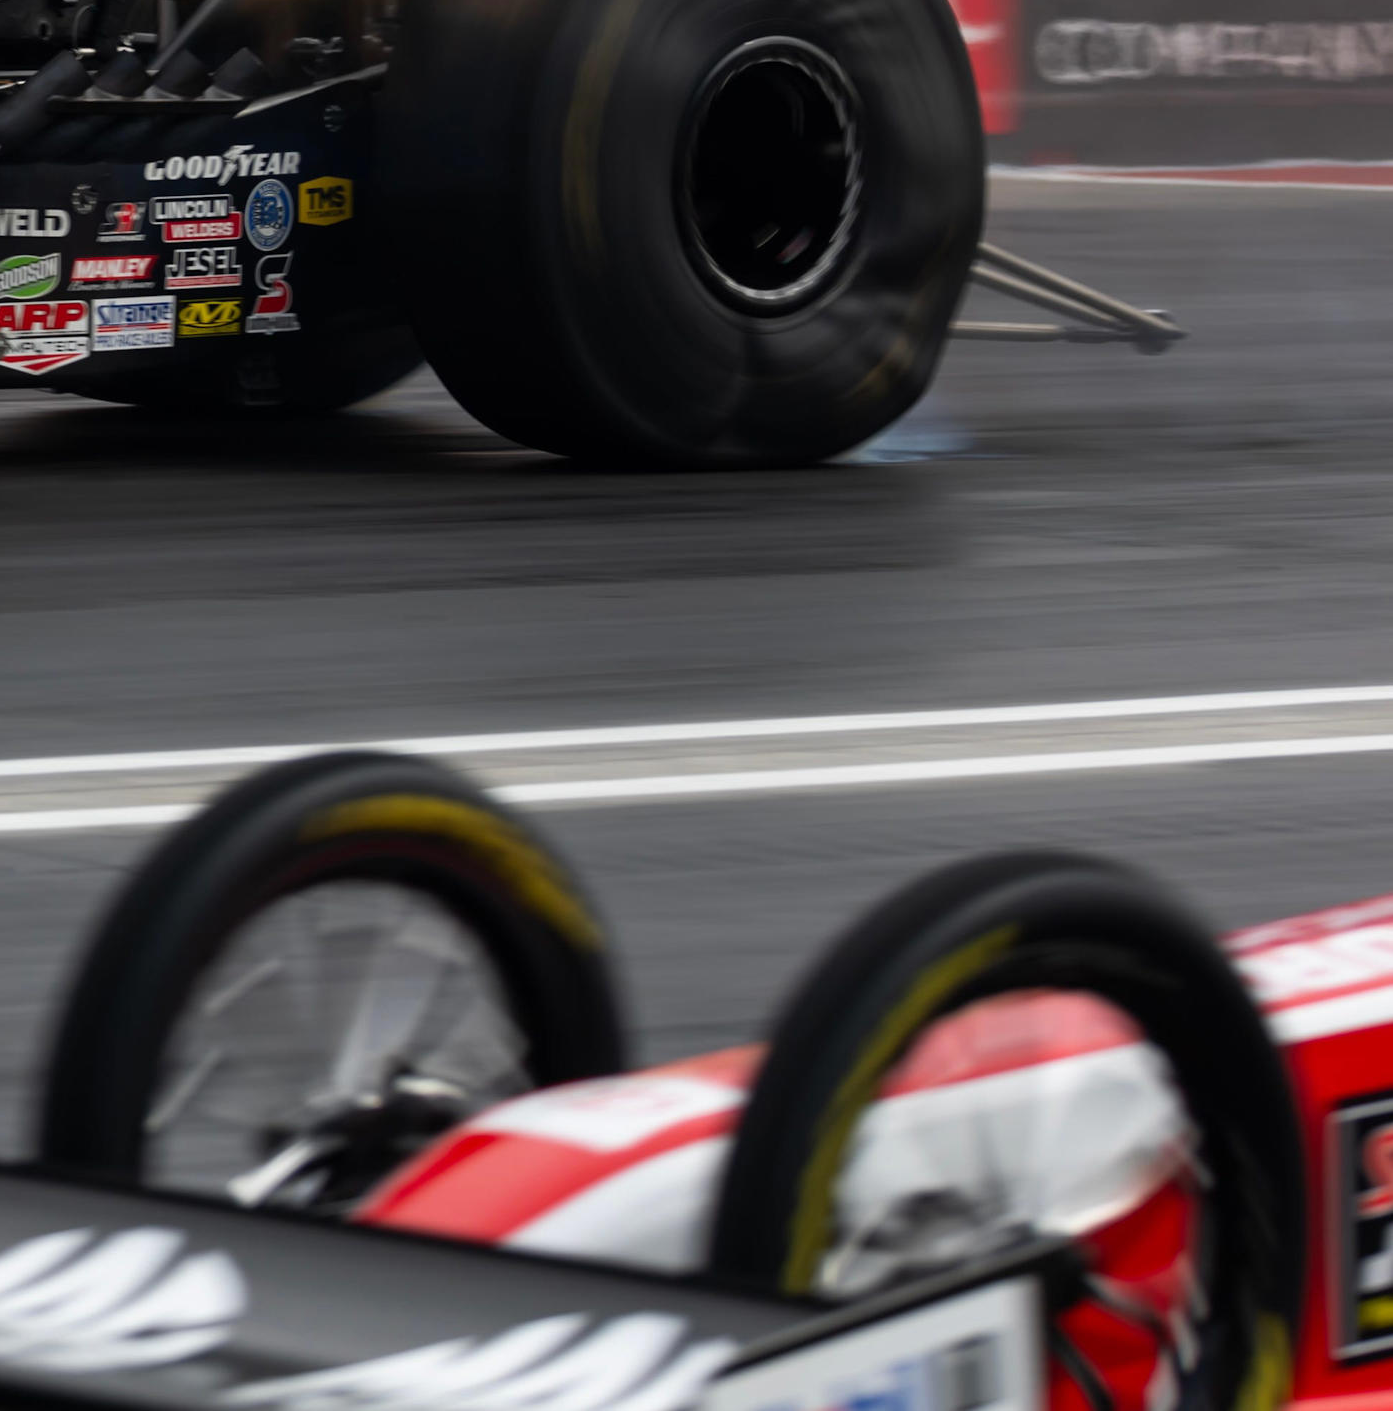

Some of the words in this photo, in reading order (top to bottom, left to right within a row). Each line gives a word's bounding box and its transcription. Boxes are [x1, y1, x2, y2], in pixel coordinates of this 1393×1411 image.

[144, 145, 301, 186] GOODYEAR
[307, 185, 345, 209] TMS
[155, 199, 227, 220] LINCOLN
[170, 221, 234, 239] WELDERS
[71, 257, 153, 279] MANLEY
[169, 248, 242, 278] JESEL
